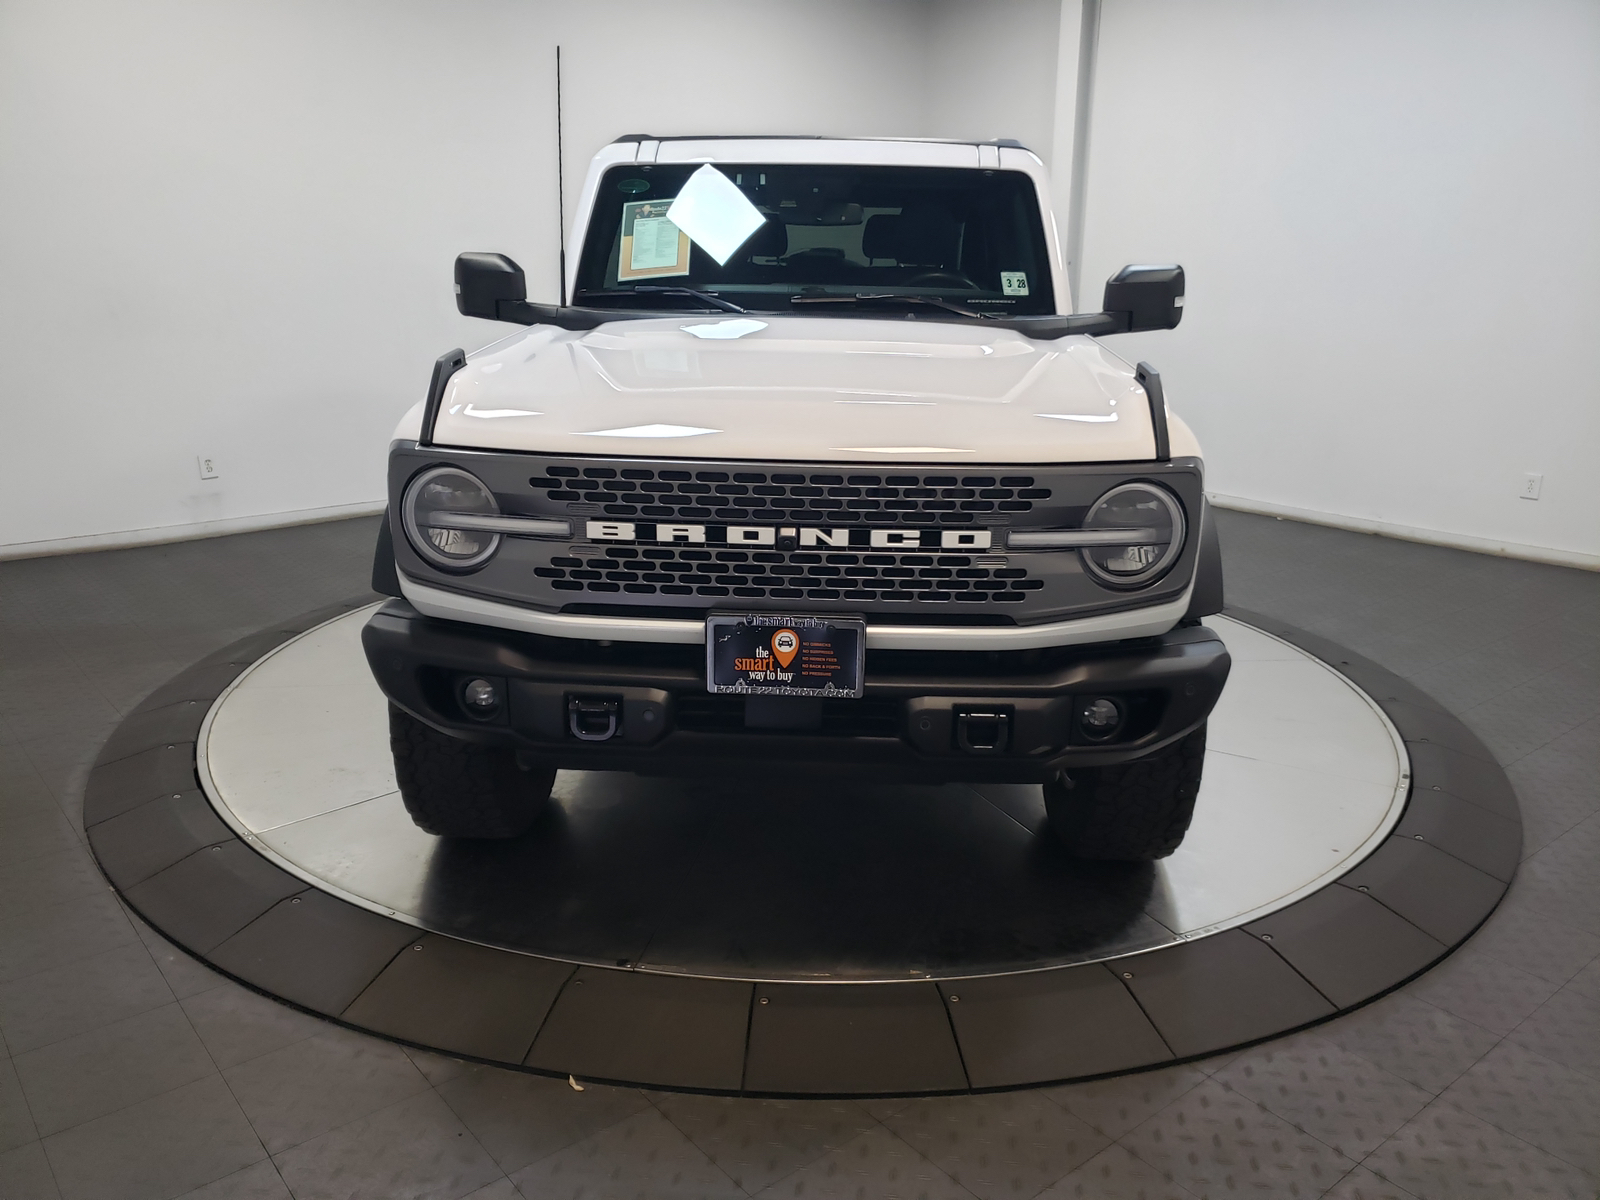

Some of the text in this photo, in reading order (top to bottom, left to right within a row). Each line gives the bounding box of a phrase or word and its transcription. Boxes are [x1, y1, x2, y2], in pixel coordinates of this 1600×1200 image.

[1006, 278, 1027, 289] 3 28
[586, 520, 992, 549] BRONCO
[755, 645, 769, 659] the
[734, 655, 775, 671] smart
[749, 668, 794, 683] way to buy
